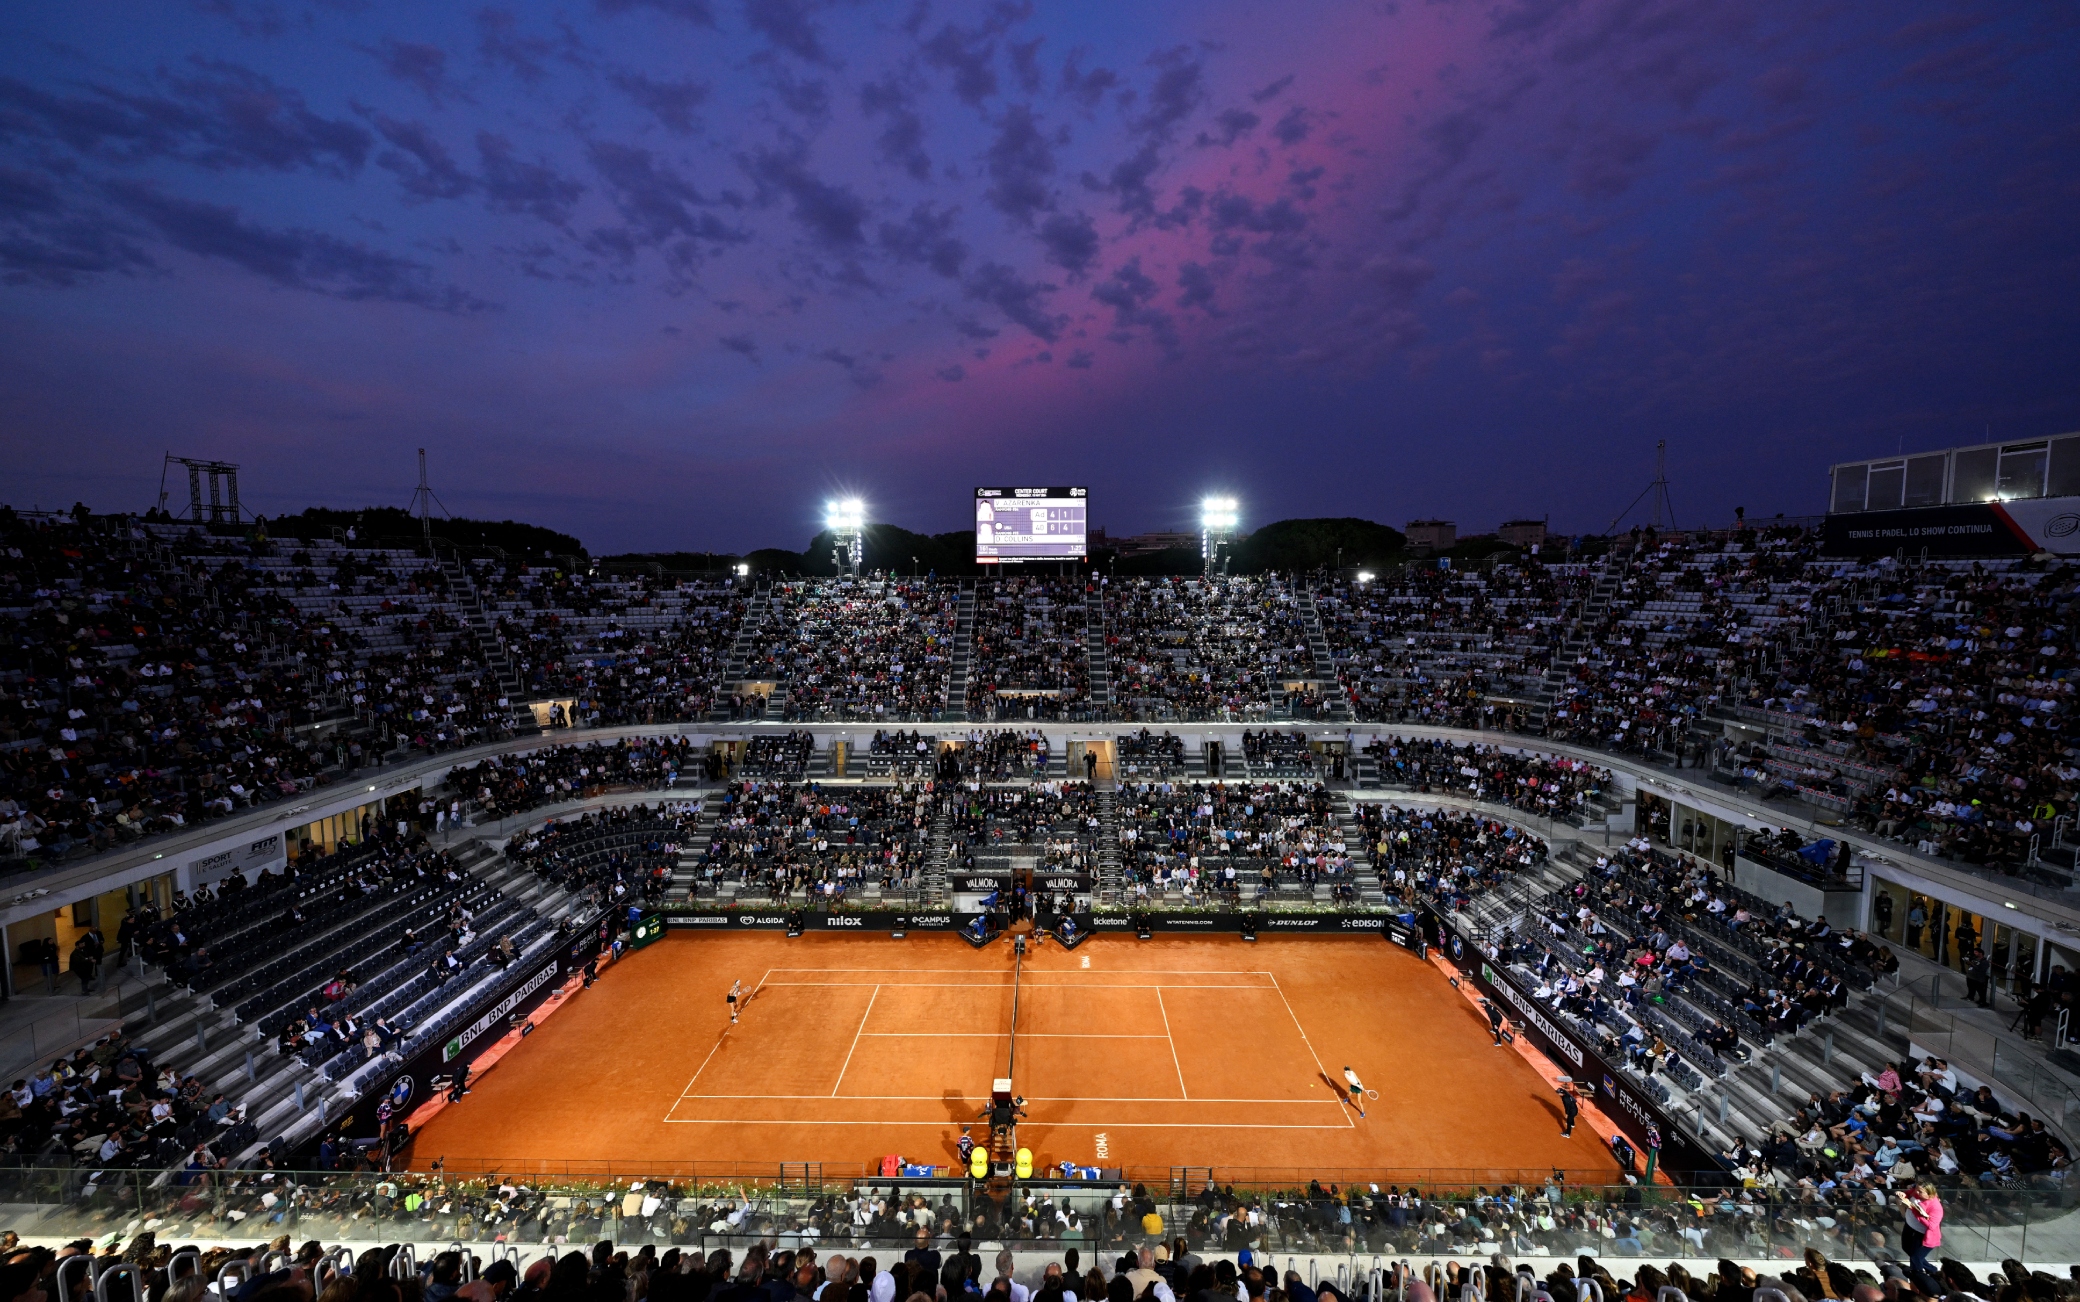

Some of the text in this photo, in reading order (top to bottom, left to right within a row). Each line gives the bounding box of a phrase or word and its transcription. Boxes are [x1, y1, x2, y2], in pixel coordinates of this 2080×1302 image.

[1848, 524, 1993, 539] TENNIS E PADEL, LO SHOW CONTINUA
[202, 852, 232, 868] SPORT
[208, 859, 233, 870] SALUTE
[966, 878, 999, 888] VALMORA
[1046, 878, 1079, 888] VALMORA
[827, 916, 862, 926] nilox
[1093, 917, 1128, 925] ticketone
[461, 963, 556, 1046] BNL BNP PARIBAS
[1493, 975, 1580, 1063] BNL BNP PARIBAS
[1619, 1089, 1652, 1124] REALE
[1095, 1132, 1109, 1159] ROMA
